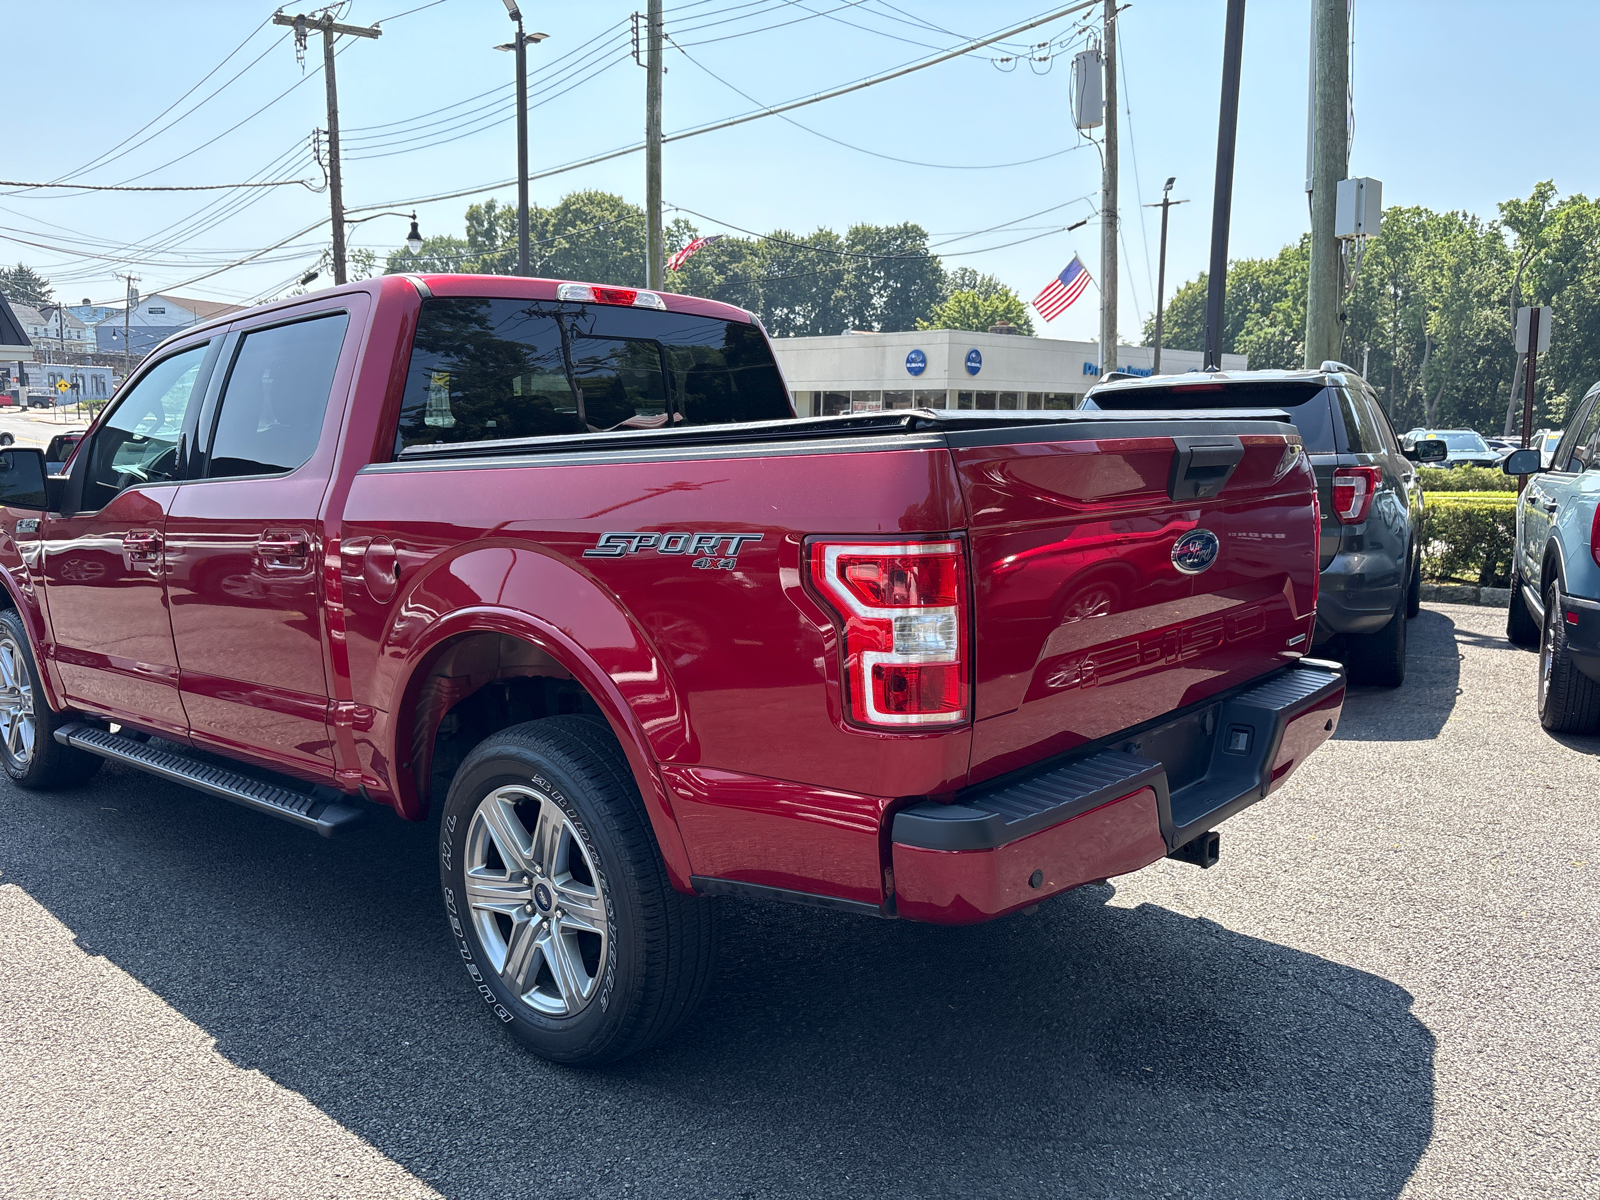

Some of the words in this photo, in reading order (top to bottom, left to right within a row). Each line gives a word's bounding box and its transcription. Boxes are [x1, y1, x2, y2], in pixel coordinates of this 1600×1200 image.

[582, 531, 764, 558] SPORT
[442, 814, 458, 871] H/L
[444, 886, 515, 1024] DUELER
